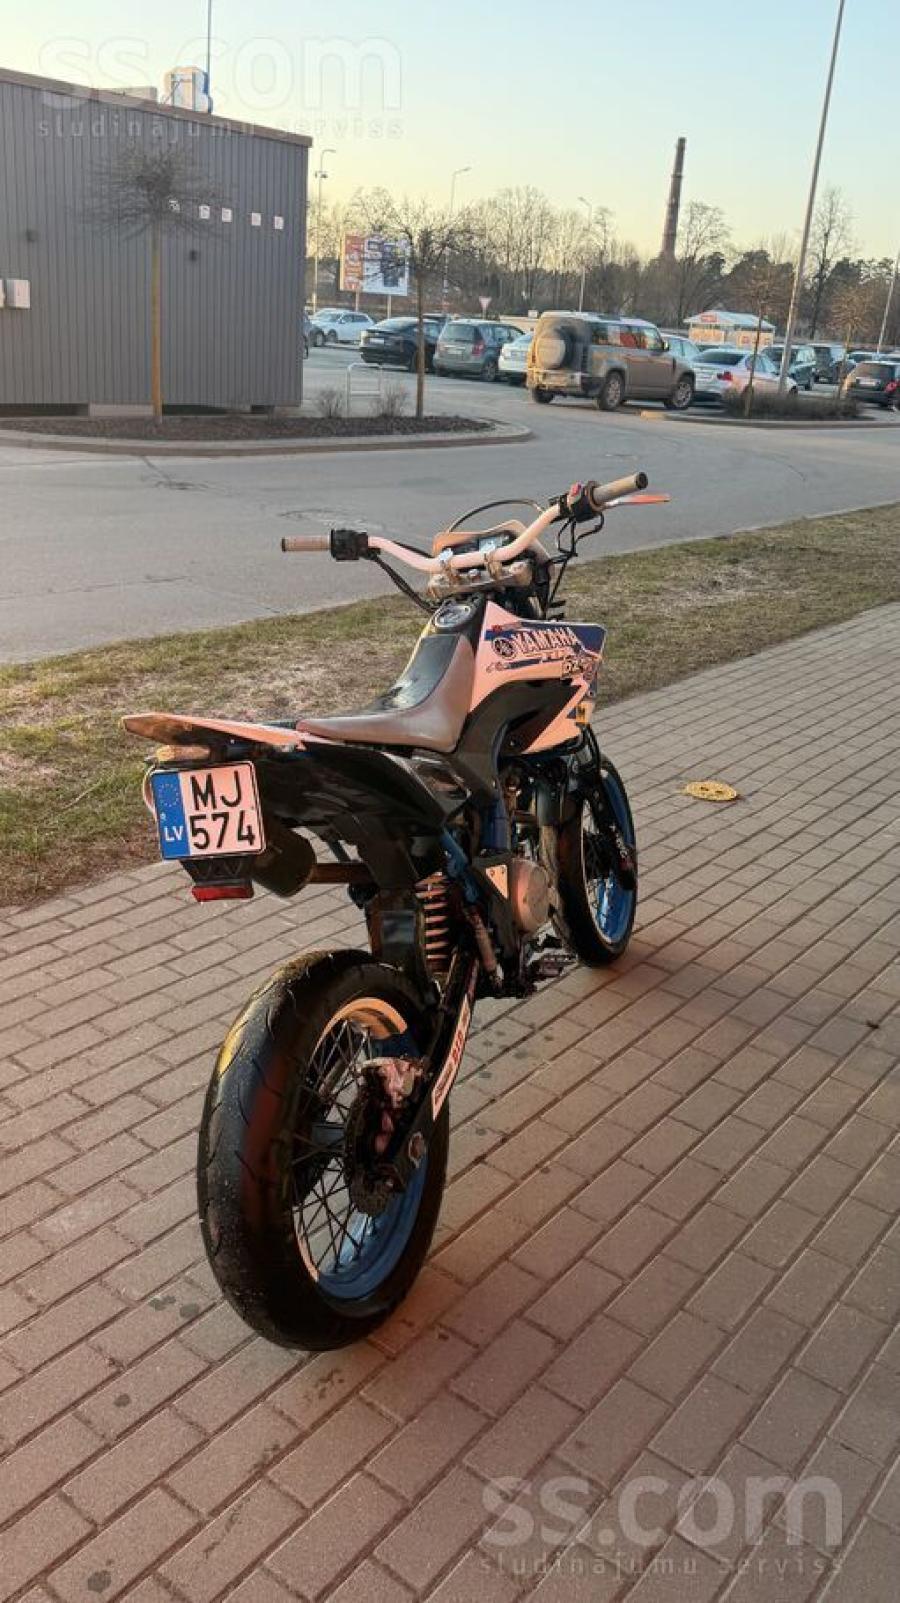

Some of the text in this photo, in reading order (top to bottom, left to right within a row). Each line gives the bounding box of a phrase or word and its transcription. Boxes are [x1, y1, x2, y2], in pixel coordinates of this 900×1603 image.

[511, 626, 579, 652] YAMAHA
[190, 770, 242, 811] MJ
[164, 826, 184, 841] LV
[189, 810, 255, 850] 574
